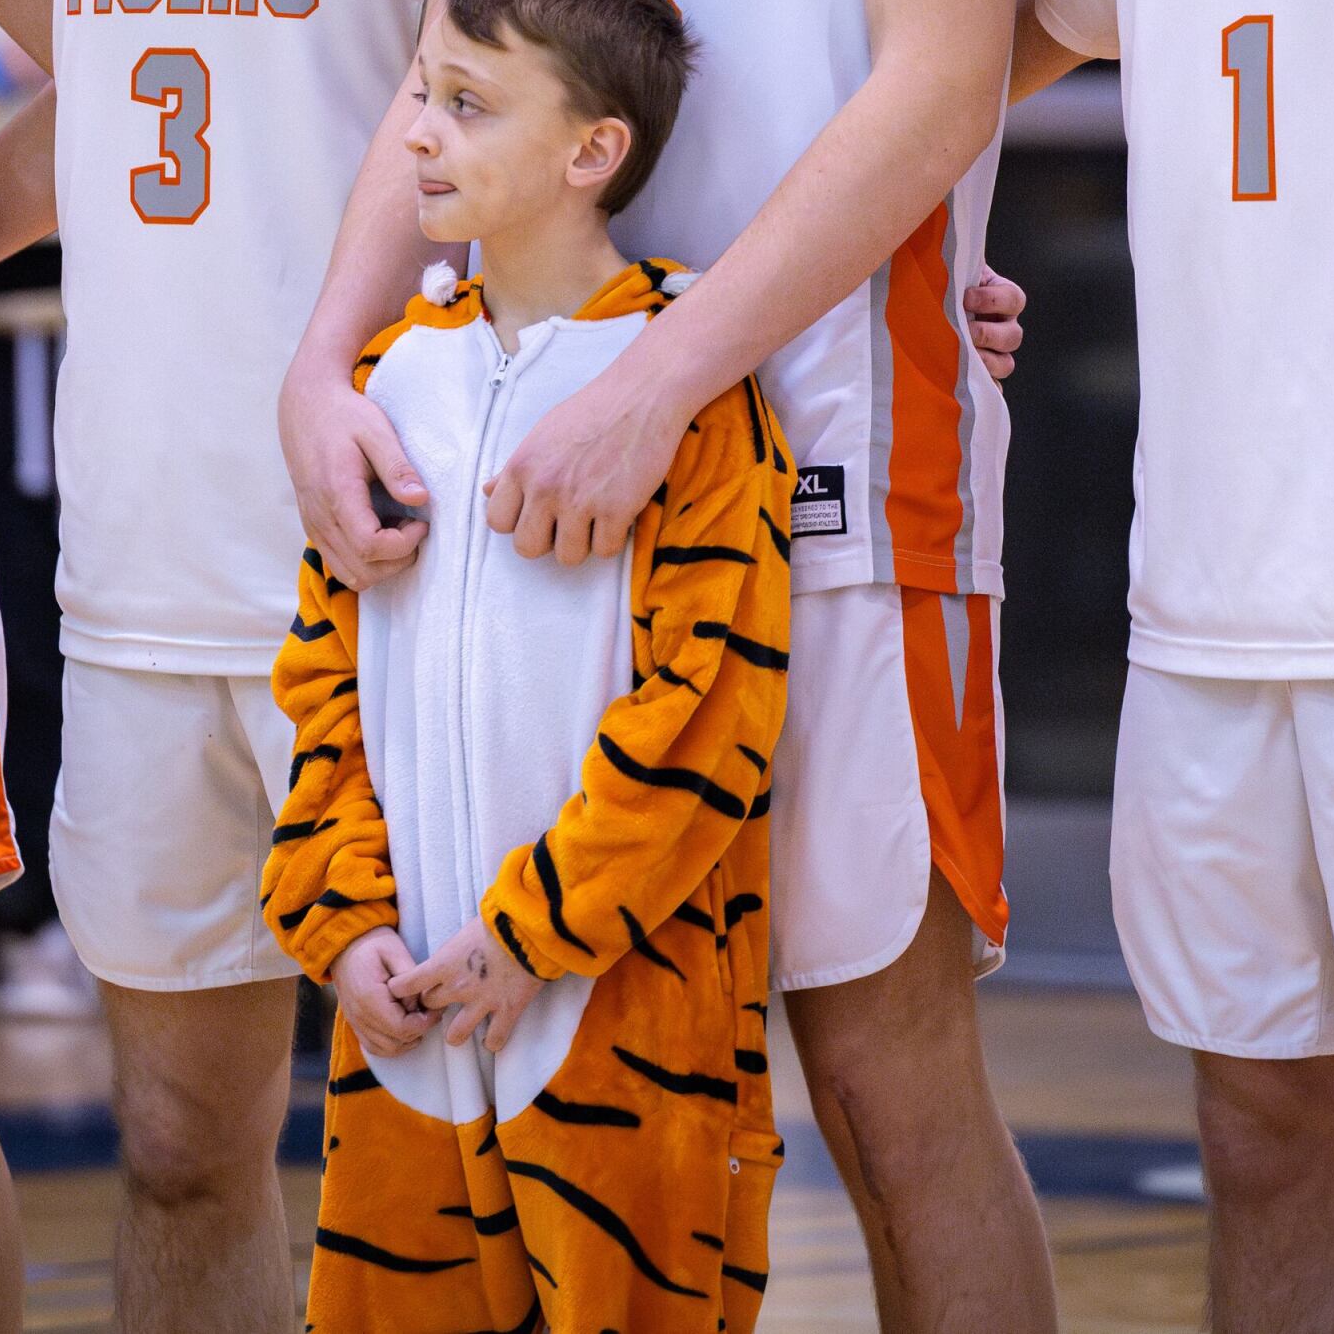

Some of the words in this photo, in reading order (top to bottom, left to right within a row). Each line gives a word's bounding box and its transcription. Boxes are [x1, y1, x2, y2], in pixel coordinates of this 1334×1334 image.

[130, 47, 210, 225] 3
[1222, 14, 1276, 202] 1
[796, 474, 828, 495] XL
